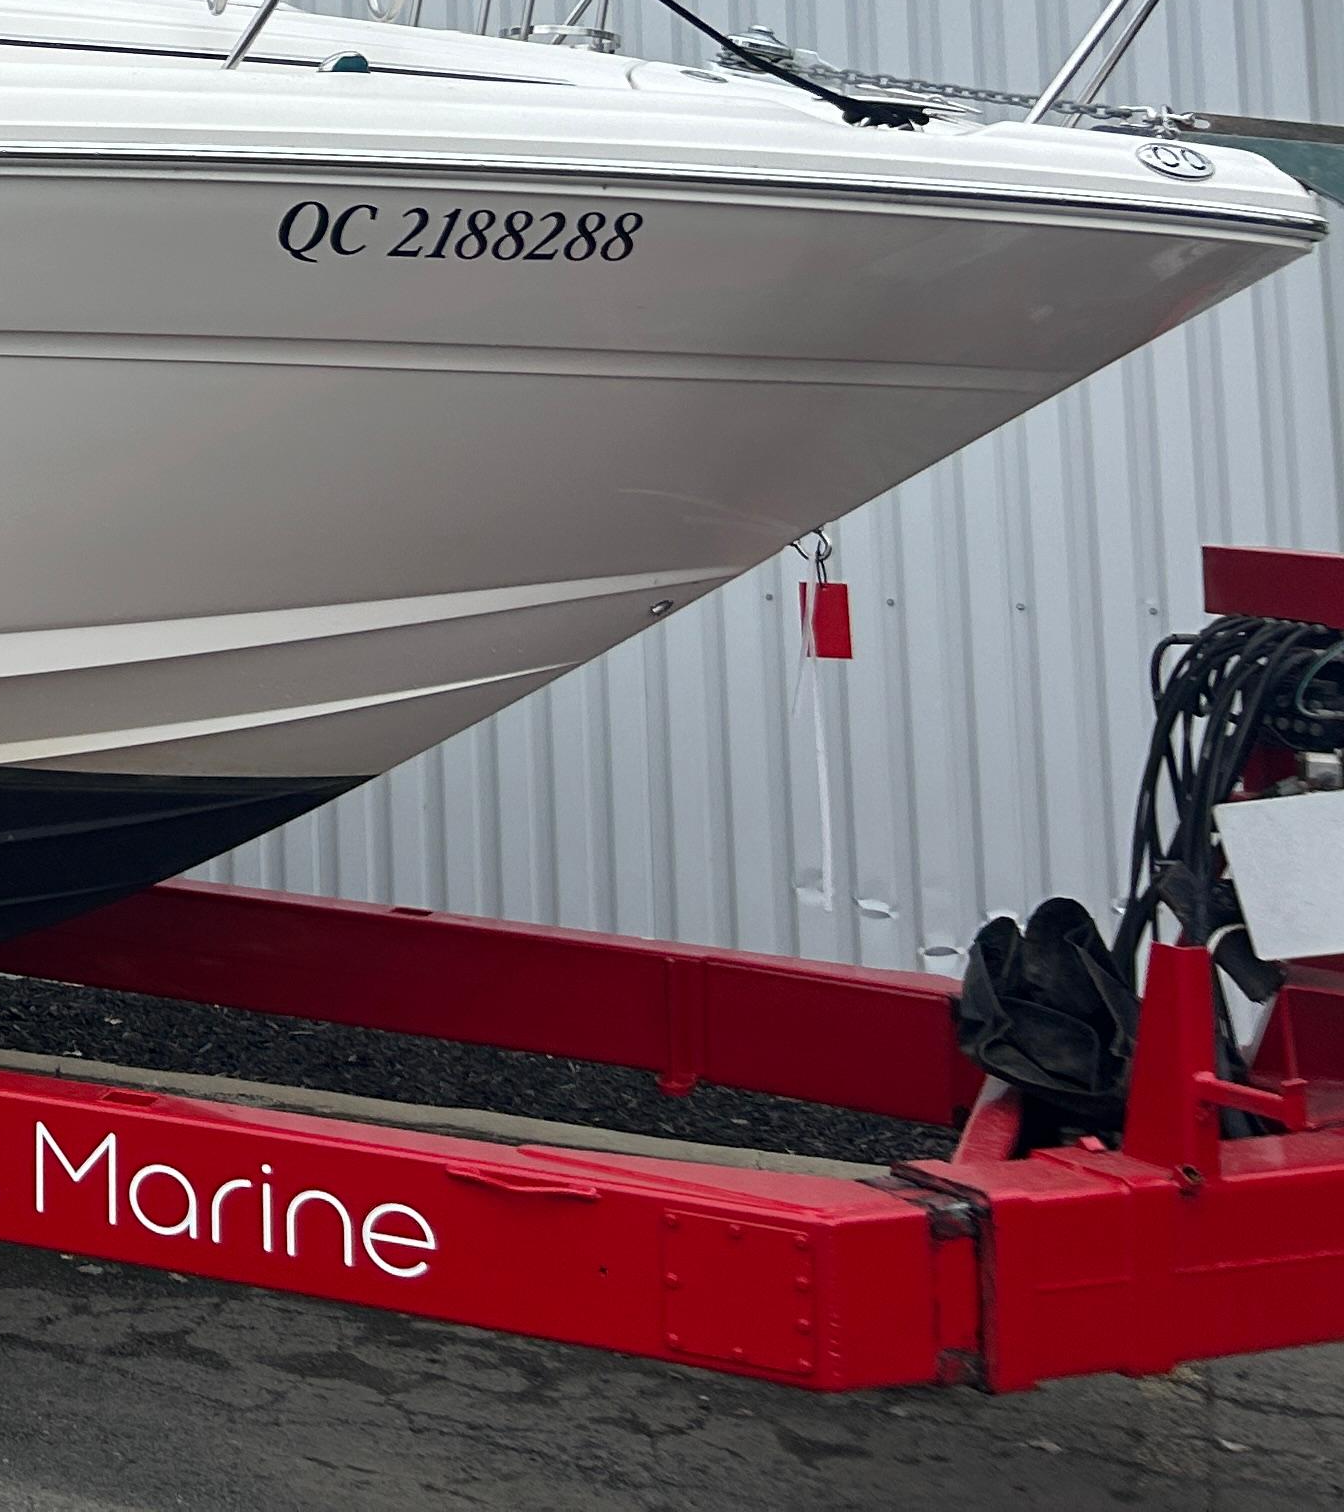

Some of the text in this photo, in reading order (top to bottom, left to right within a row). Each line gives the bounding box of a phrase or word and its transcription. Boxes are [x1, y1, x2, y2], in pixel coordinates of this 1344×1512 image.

[278, 200, 644, 263] QC 2188288
[35, 1121, 437, 1278] Marine
